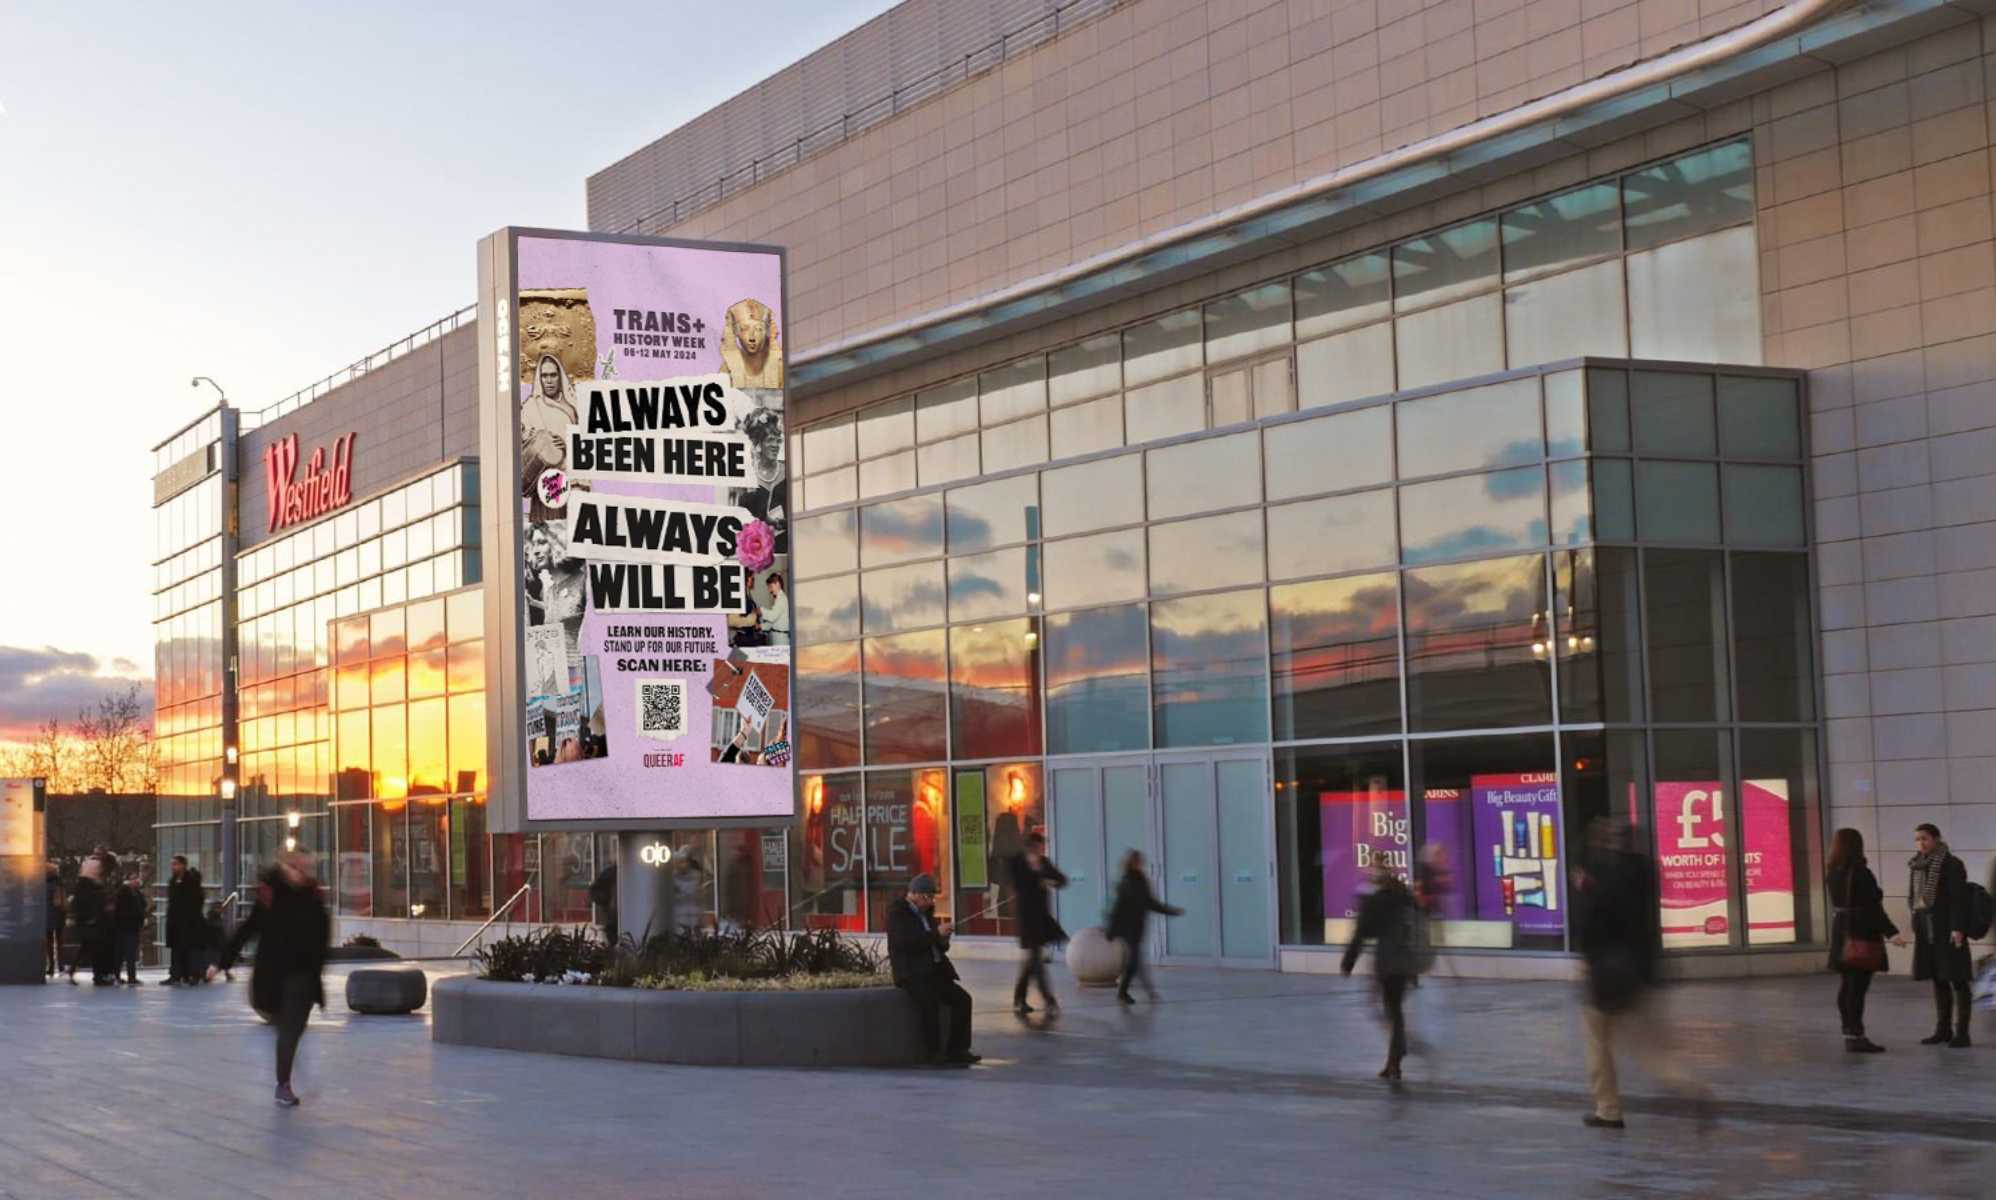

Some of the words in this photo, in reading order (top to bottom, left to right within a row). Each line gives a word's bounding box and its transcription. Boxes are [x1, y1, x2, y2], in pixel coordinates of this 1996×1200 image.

[613, 309, 705, 334] TRANS+
[614, 333, 669, 347] HISTORY
[671, 335, 705, 349] WEEK
[652, 349, 672, 359] MAY
[674, 350, 697, 360] 2024
[588, 383, 727, 434] ALWAYS
[572, 433, 655, 473] BEEN
[663, 438, 746, 477] HERE
[264, 432, 357, 534] Westfield
[572, 503, 743, 557] ALWAYS
[589, 563, 686, 609] WILL
[693, 565, 742, 609] BE
[607, 626, 642, 638] LEARN
[643, 626, 666, 638] OUR
[667, 626, 715, 639] HISTORY.
[603, 640, 632, 653] STAND
[633, 640, 646, 653] UP
[647, 641, 664, 653] FOR
[665, 641, 683, 653] OUR
[684, 641, 719, 654] FUTURE.
[617, 659, 660, 672] SCAN
[662, 660, 707, 672] HERE:
[643, 753, 685, 768] QUEERAF
[1504, 790, 1537, 806] Beauty
[831, 806, 863, 826] HALF
[867, 804, 908, 824] PRICE
[1373, 811, 1408, 845] Big
[831, 826, 908, 872] SALE
[1662, 855, 1702, 867] WORTH
[1704, 855, 1721, 866] OF
